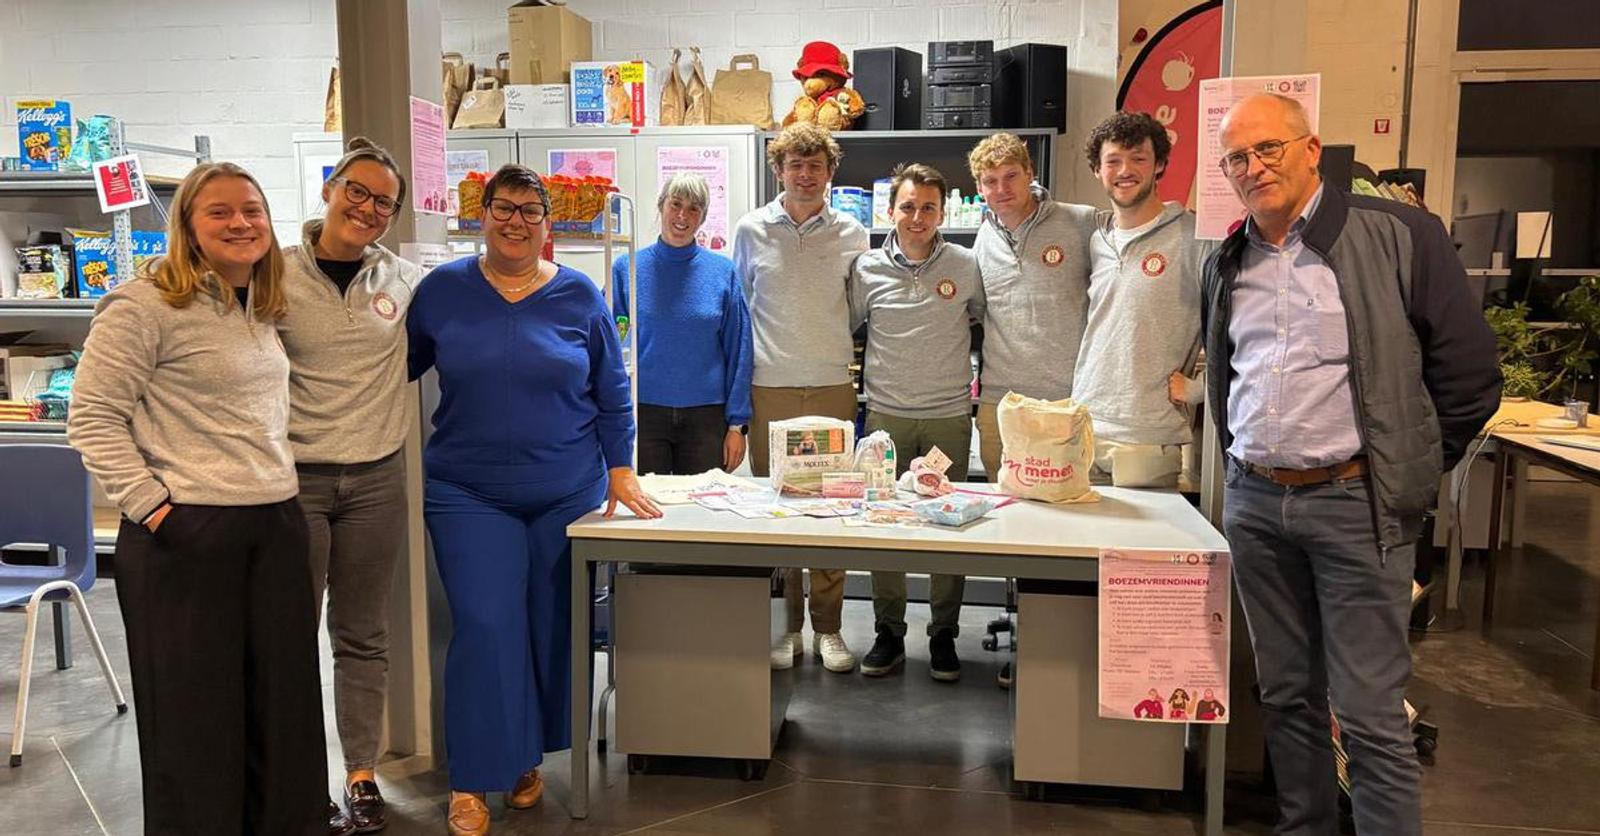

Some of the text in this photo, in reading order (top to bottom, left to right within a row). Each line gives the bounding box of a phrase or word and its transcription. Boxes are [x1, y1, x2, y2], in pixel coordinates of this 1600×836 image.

[18, 108, 65, 127] Kellogg's
[1025, 456, 1050, 467] stad
[1025, 464, 1073, 478] menen
[1108, 577, 1210, 586] BOEZEMVRIENDINNEN
